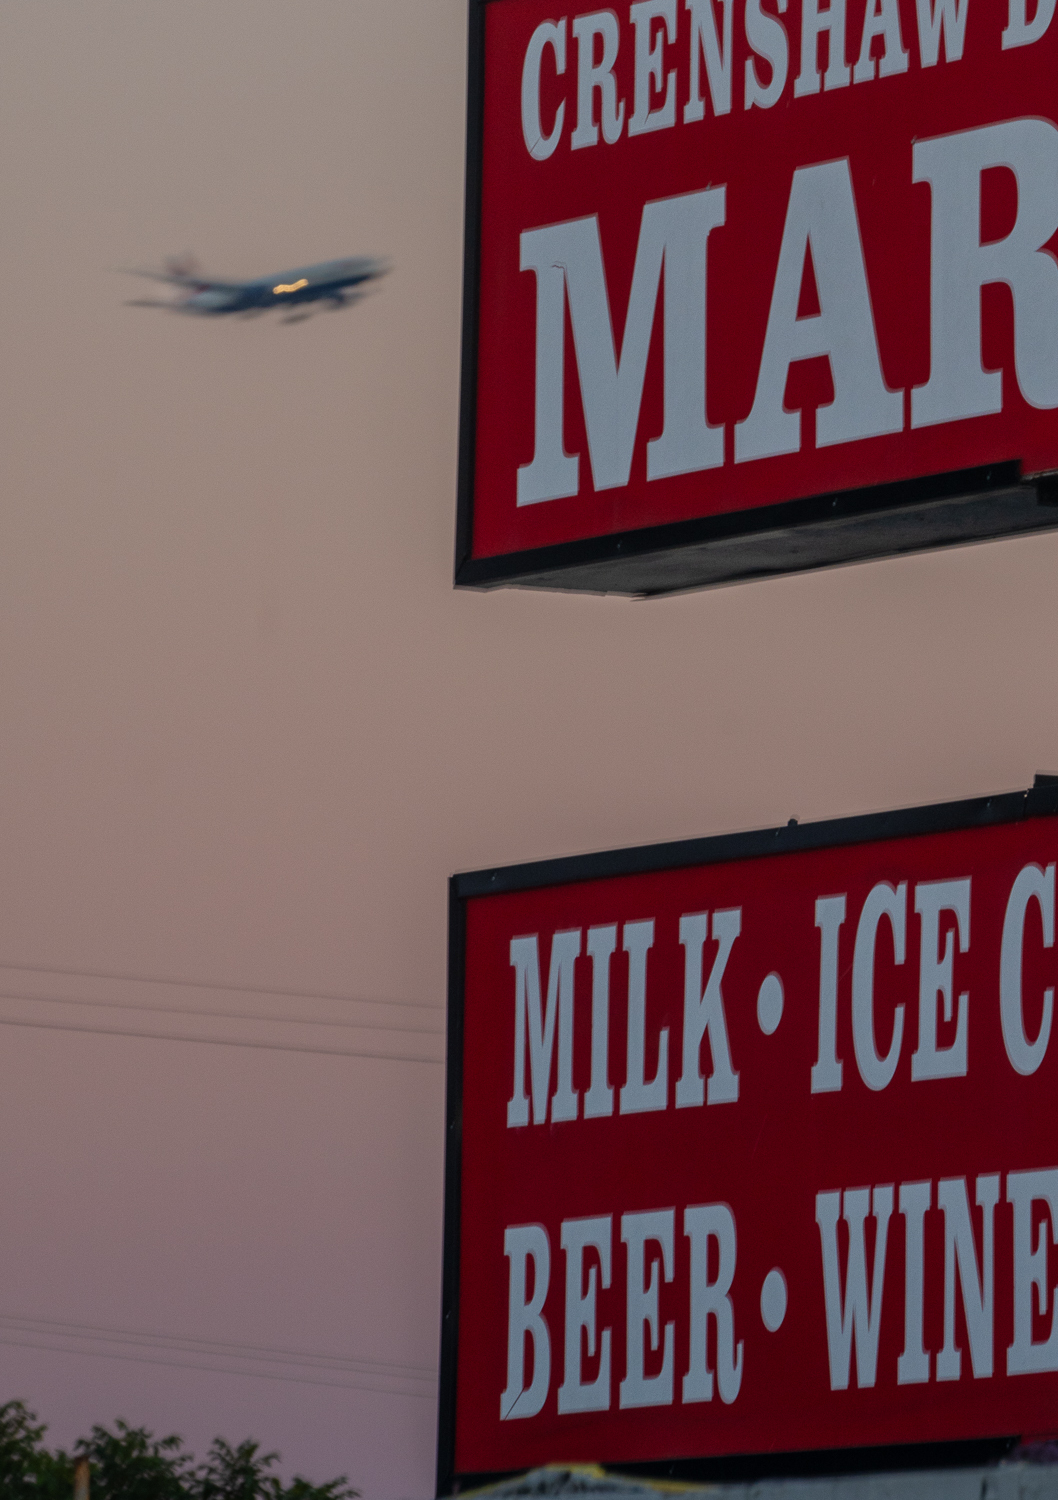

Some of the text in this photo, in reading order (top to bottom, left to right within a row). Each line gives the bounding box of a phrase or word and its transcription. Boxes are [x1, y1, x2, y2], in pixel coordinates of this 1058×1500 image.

[505, 908, 742, 1129] MILK
[810, 877, 972, 1095] ICE
[499, 1204, 744, 1421] BEER
